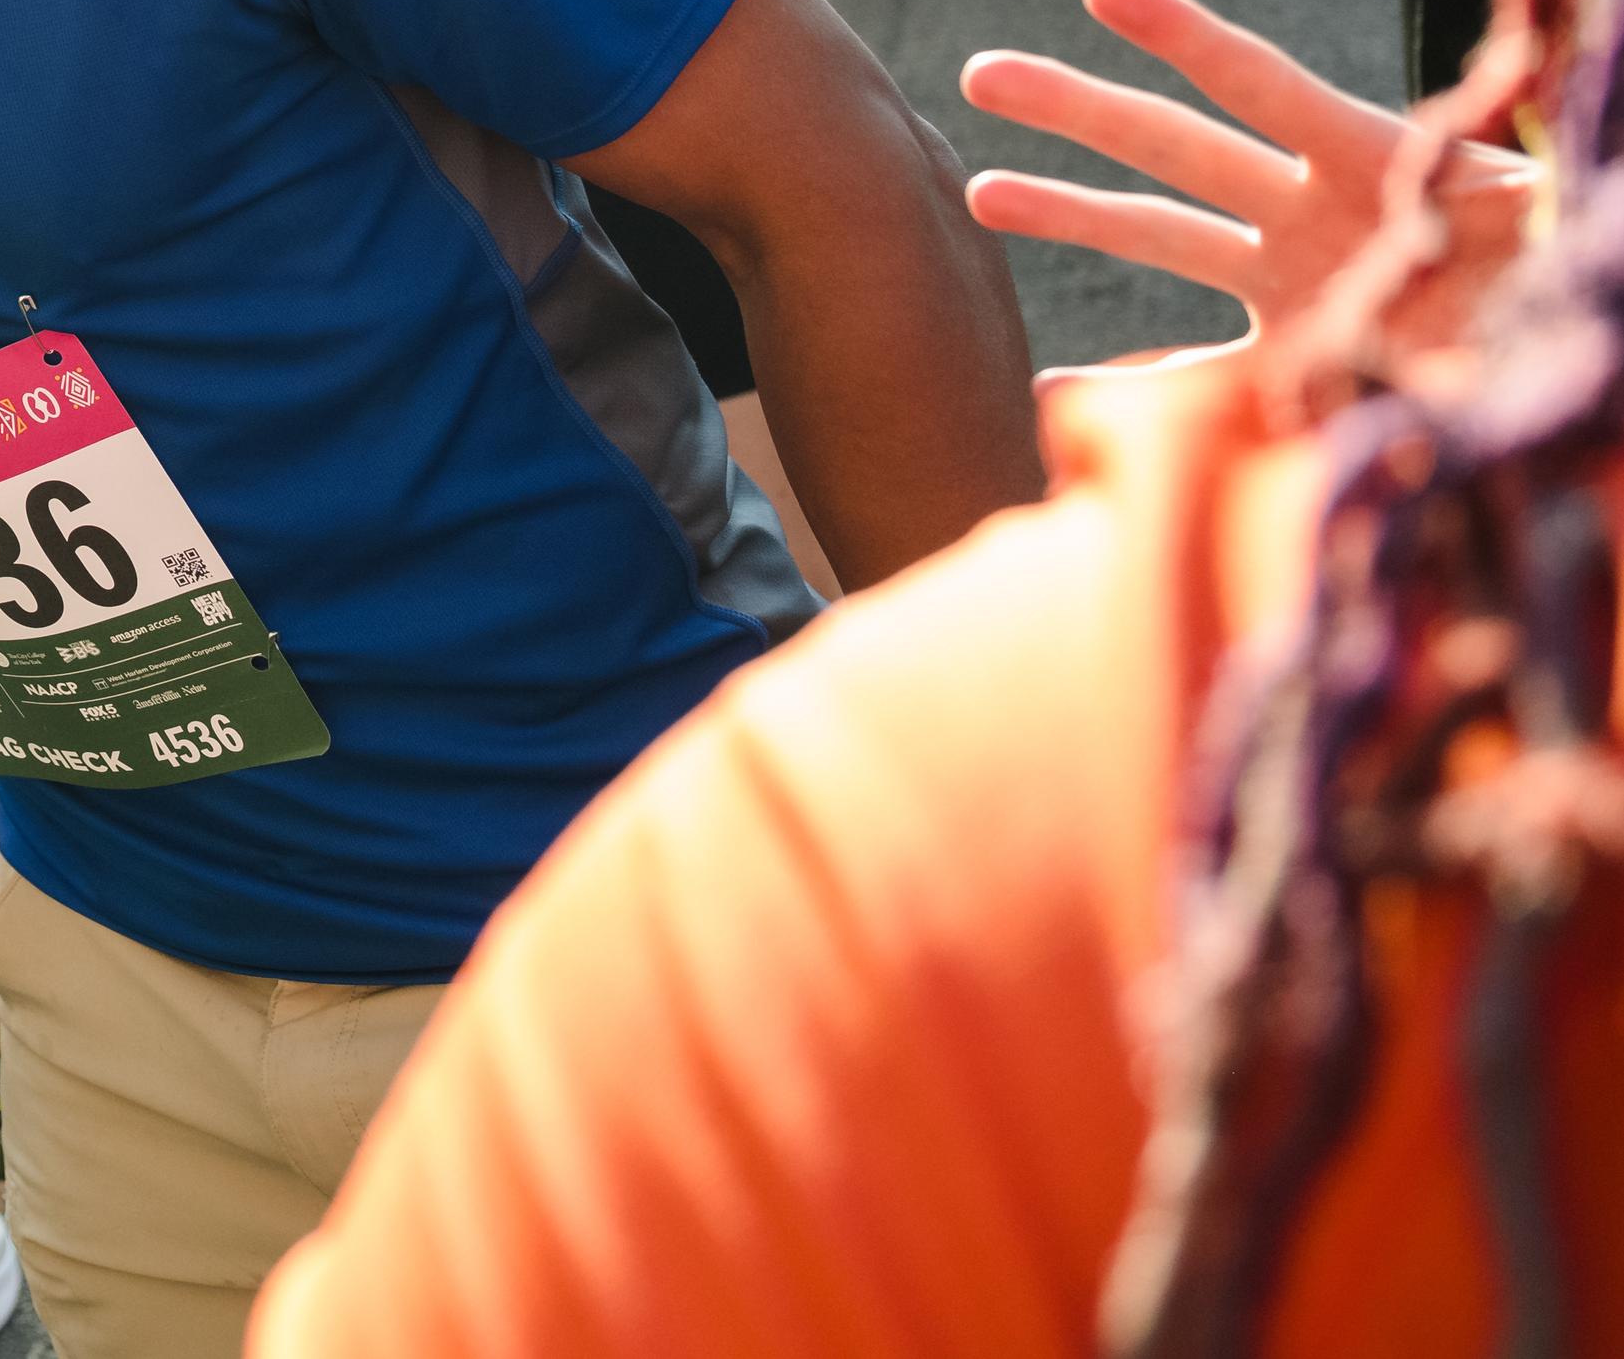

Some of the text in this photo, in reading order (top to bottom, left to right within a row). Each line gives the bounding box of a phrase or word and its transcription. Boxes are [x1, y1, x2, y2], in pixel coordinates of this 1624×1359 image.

[189, 590, 225, 612] NEW
[109, 626, 149, 644] amazon
[146, 613, 182, 633] access
[105, 673, 125, 683] West
[124, 667, 149, 679] Harlem
[148, 653, 192, 671] Development
[191, 641, 233, 658] Corporation
[22, 681, 78, 696] NAACP
[78, 703, 118, 718] FOX 5
[27, 742, 134, 773] CHECK
[148, 713, 245, 768] 4536
